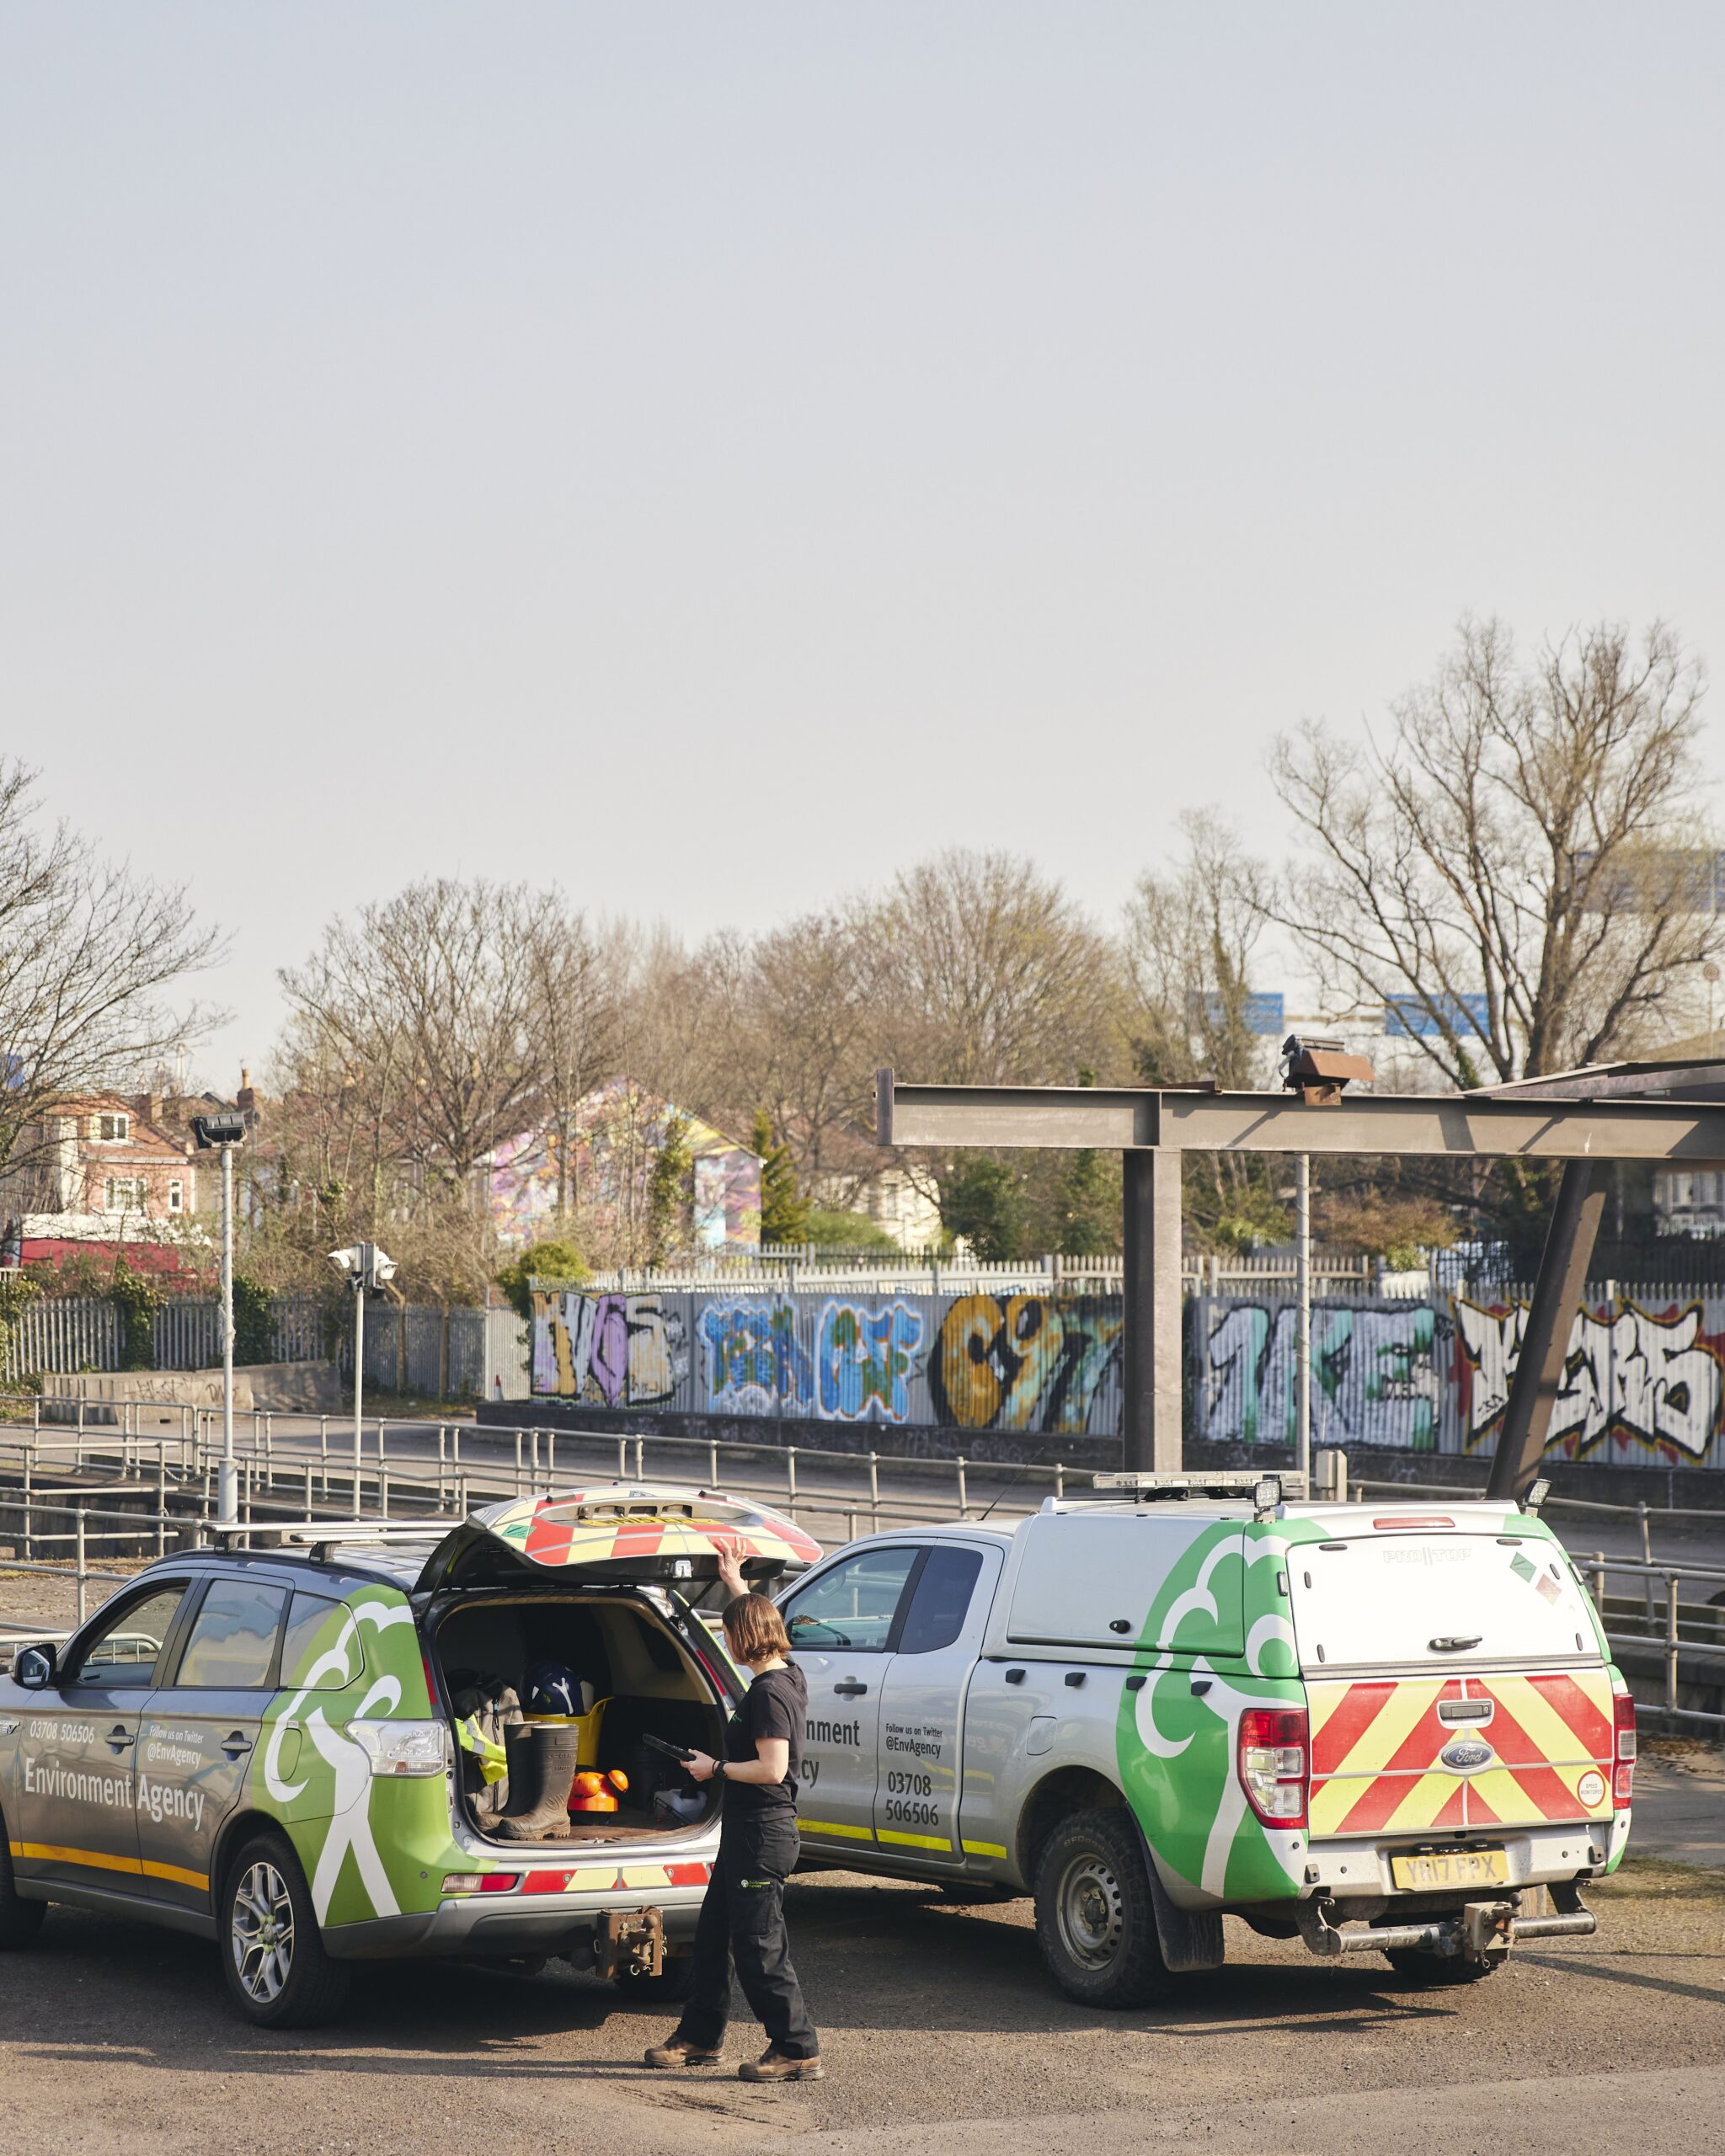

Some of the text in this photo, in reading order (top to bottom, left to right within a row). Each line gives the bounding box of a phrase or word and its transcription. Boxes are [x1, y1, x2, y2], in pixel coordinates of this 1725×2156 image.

[30, 1721, 94, 1744] 03708 506506
[149, 1725, 204, 1744] Follow us on Twitter
[885, 1723, 943, 1737] Follow us on Twitter
[147, 1742, 201, 1770] @EnvAgency
[885, 1736, 941, 1759] @EnvAgency
[1456, 1748, 1484, 1764] Ford
[24, 1757, 205, 1831] Environment Agency
[888, 1771, 932, 1797] 03708
[885, 1799, 939, 1826] 506506
[1406, 1855, 1496, 1883] YR17 FPX
